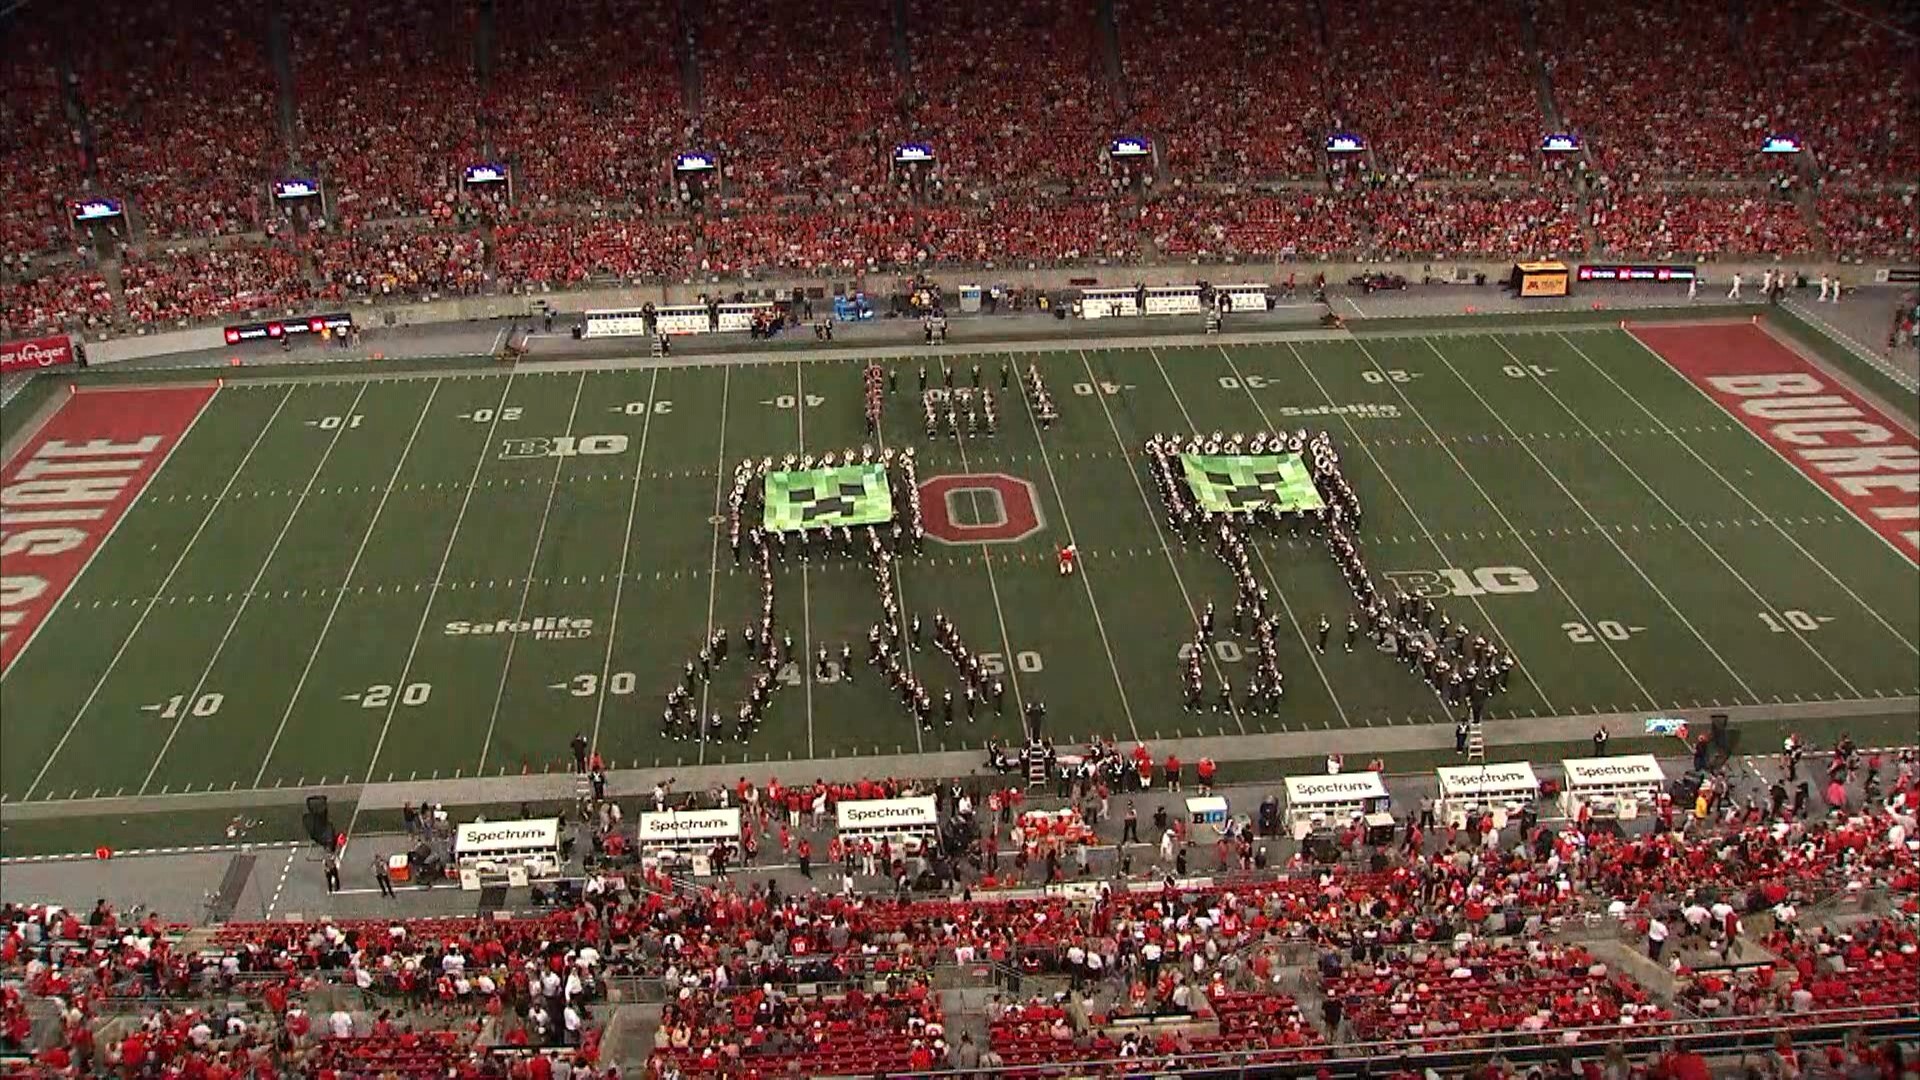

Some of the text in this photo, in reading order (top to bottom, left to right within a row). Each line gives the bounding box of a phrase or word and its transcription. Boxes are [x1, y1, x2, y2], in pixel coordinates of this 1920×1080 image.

[17, 343, 66, 366] Kroger
[444, 617, 594, 635] Safelite
[1560, 620, 1631, 643] 20
[1757, 610, 1820, 632] 10
[978, 651, 1043, 674] 50
[361, 683, 433, 708] 20
[571, 672, 637, 697] 30
[160, 692, 224, 719] 10
[1575, 764, 1649, 779] Spectrum
[1296, 781, 1372, 796] Spectrum
[649, 817, 727, 832] Spectrum
[847, 806, 923, 821] Spectrum
[467, 829, 545, 844] Spectrum
